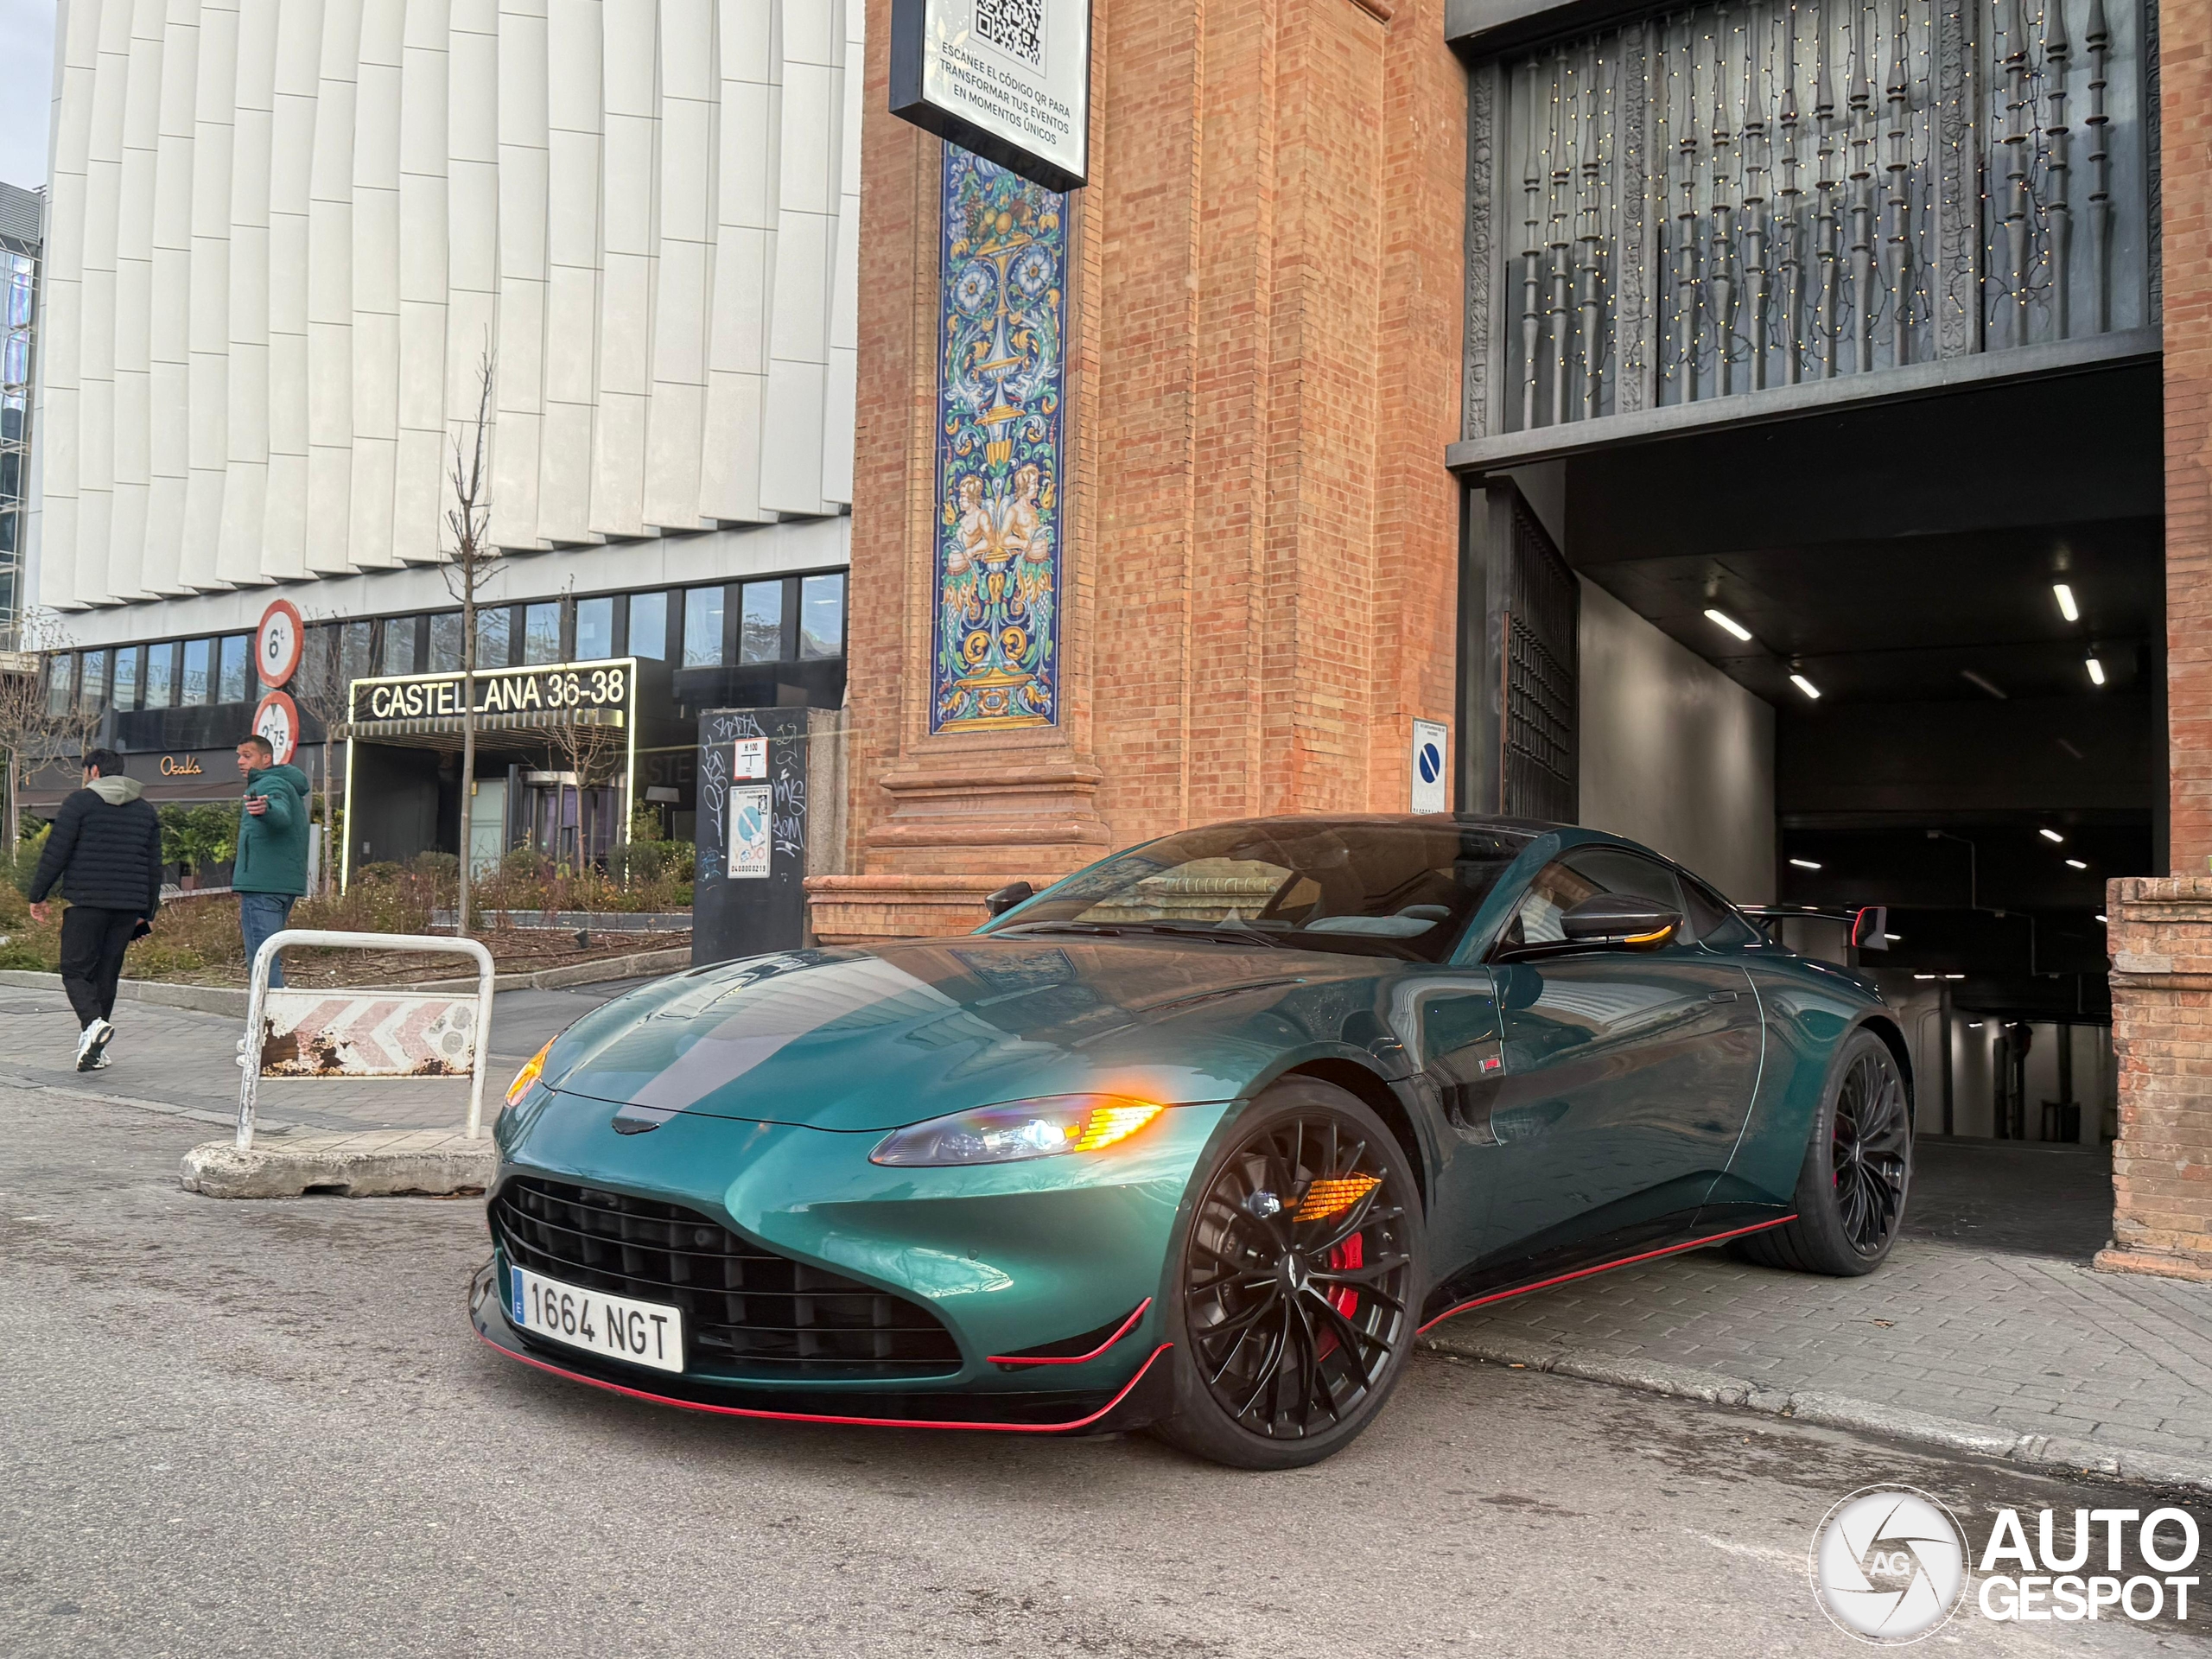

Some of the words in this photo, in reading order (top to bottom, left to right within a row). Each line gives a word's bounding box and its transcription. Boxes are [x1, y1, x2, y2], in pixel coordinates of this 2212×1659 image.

[940, 58, 1009, 105] TRANSFORMAR
[1011, 95, 1028, 114] TUS
[1031, 105, 1069, 135] EVENTOS
[942, 41, 985, 73] ESCANEE
[987, 65, 997, 80] EL
[999, 73, 1033, 99] CÓDIGO
[1034, 91, 1047, 106] QR
[1049, 98, 1071, 118] PARA
[954, 84, 967, 100] EN
[969, 92, 1021, 128] MOMENTOS
[1024, 118, 1057, 145] ÚNICOS
[372, 676, 541, 718] CASTELANA
[548, 669, 625, 708] 36-38
[517, 1302, 522, 1314] E
[532, 1282, 595, 1342] 1664
[606, 1304, 668, 1360] NGT
